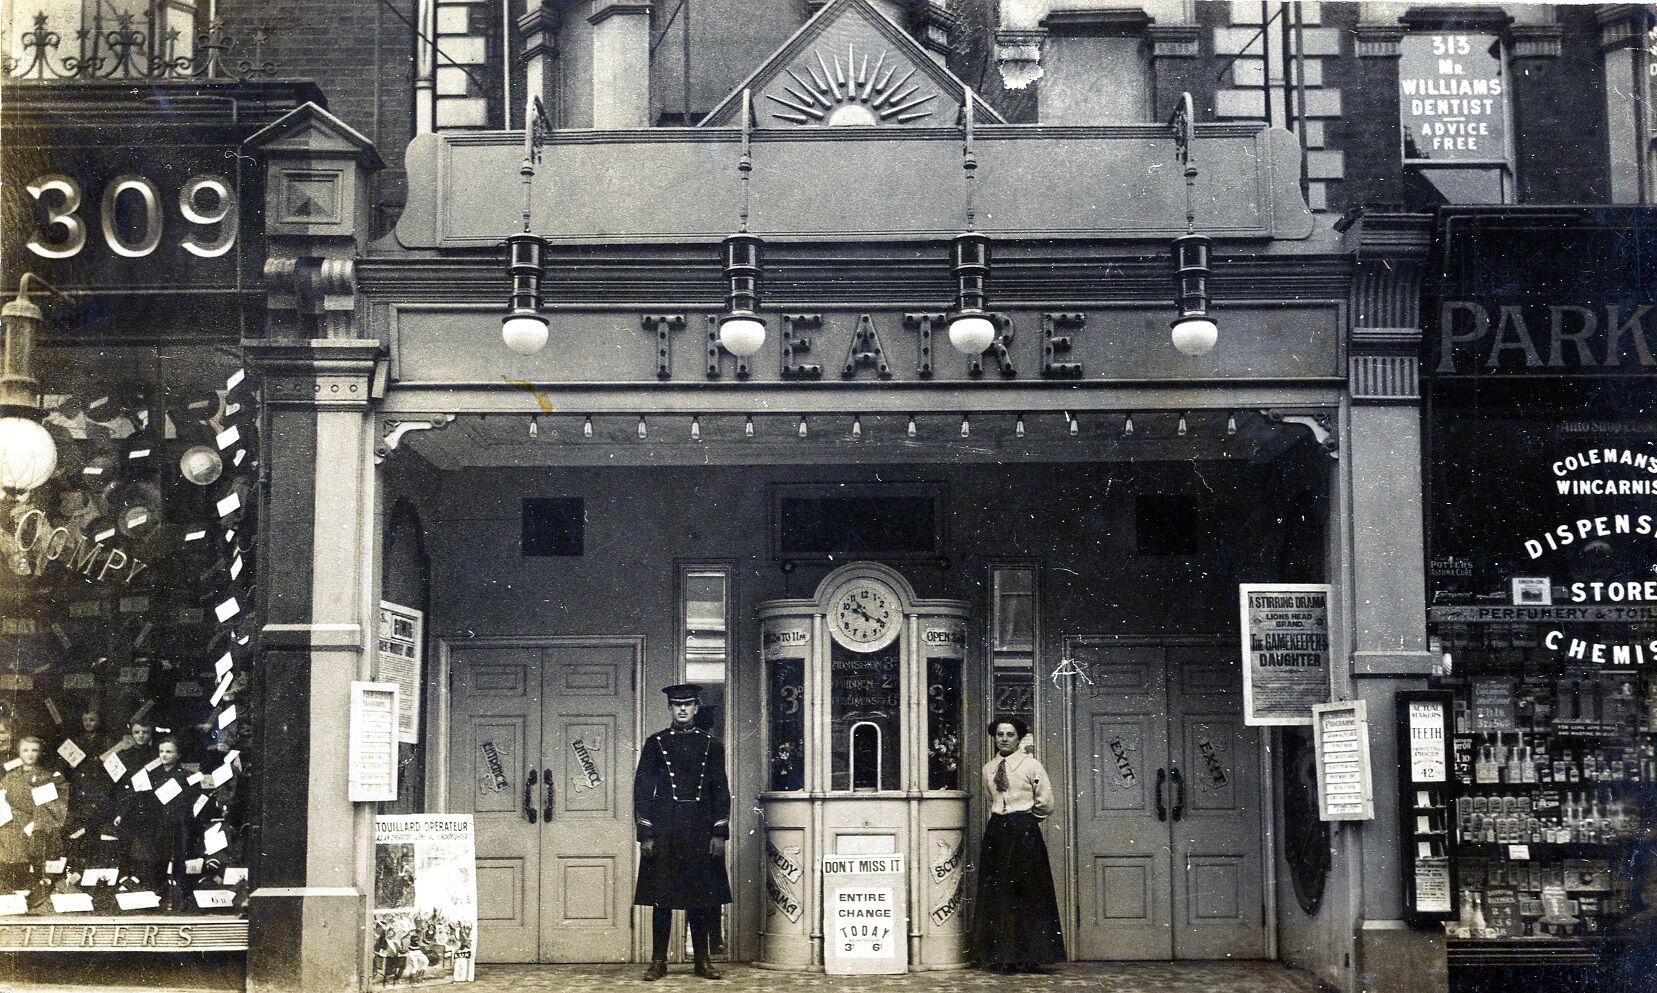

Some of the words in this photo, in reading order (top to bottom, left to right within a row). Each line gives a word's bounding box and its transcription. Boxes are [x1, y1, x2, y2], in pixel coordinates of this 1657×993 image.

[1432, 36, 1470, 54] 313
[1402, 79, 1501, 95] WILLIAMS
[1412, 100, 1494, 115] DENTIST
[1422, 123, 1489, 135] ADVICE
[1433, 137, 1477, 150] FREE
[26, 174, 240, 259] 309
[1435, 301, 1657, 374] PARK
[641, 312, 1086, 381] THEATRE
[1524, 514, 1657, 559] DISPENS
[1255, 596, 1294, 609] STIRRING
[1295, 596, 1326, 609] DRAMA
[1479, 607, 1588, 619] PERFUMERY
[926, 630, 950, 643] OPEN
[1259, 653, 1321, 667] DAUGHTER
[1411, 727, 1442, 739] TEETH
[572, 739, 602, 788] ENTRANCE
[1109, 741, 1135, 780] EXIT
[1200, 742, 1226, 783] EXIT
[859, 860, 886, 873] MISS
[890, 859, 901, 872] IT
[839, 893, 886, 902] ENTIRE
[838, 909, 892, 918] CHANGE
[0, 925, 193, 948] TURERS
[840, 925, 890, 939] TODAY
